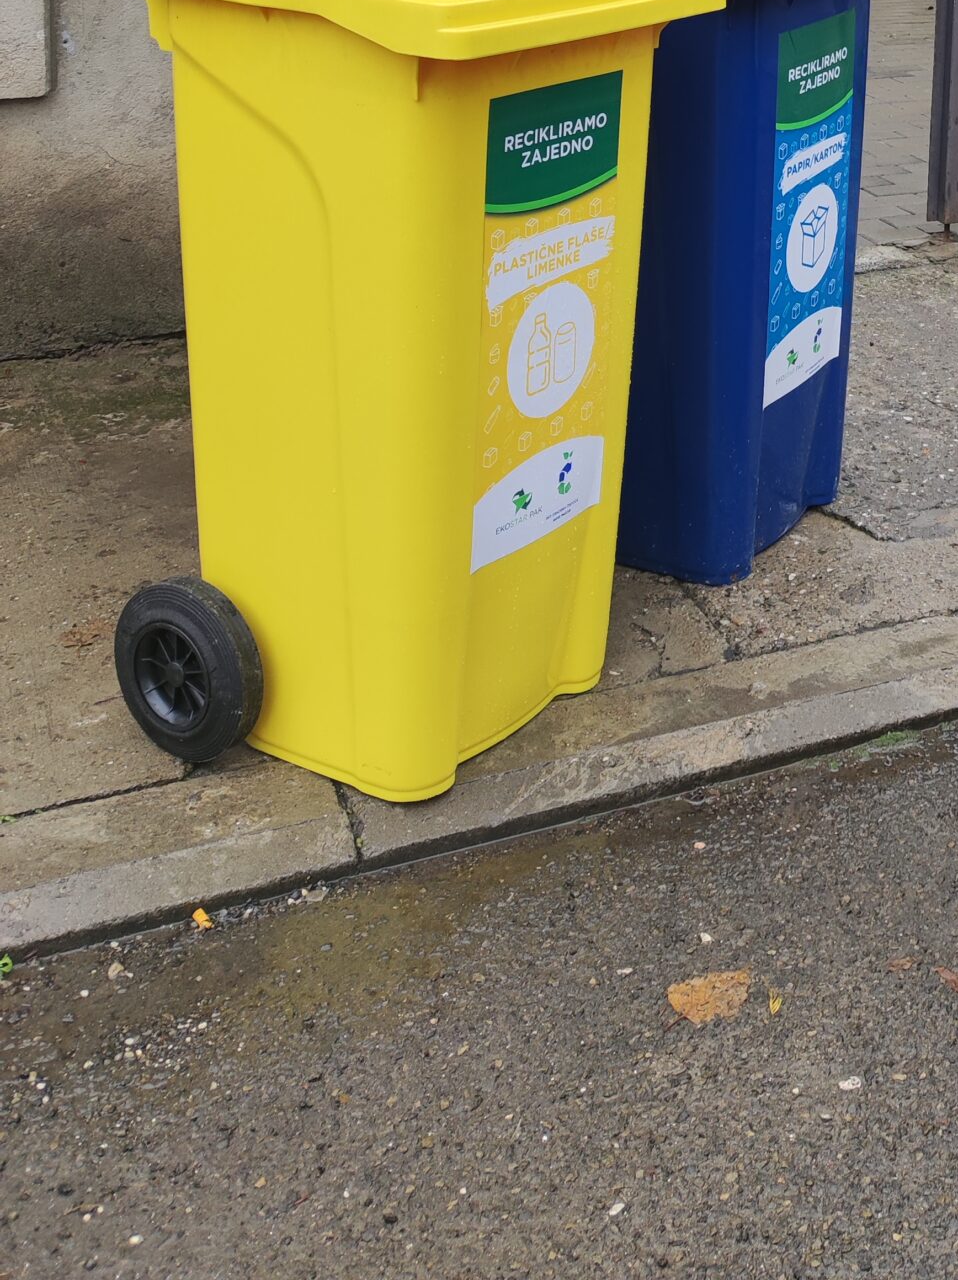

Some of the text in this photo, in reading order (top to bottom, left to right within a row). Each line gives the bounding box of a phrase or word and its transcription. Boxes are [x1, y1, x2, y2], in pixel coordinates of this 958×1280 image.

[788, 47, 848, 82] RECIKLIRAMO
[799, 66, 841, 95] ZAJEDNO
[504, 112, 607, 153] RECIKLIRAMO
[521, 135, 593, 168] ZAJEDNO
[786, 140, 843, 178] PAPIR/KARTON
[494, 242, 564, 276] PLASTIČNE
[527, 251, 581, 280] LIMENKE
[495, 514, 528, 535] EKOSTAR
